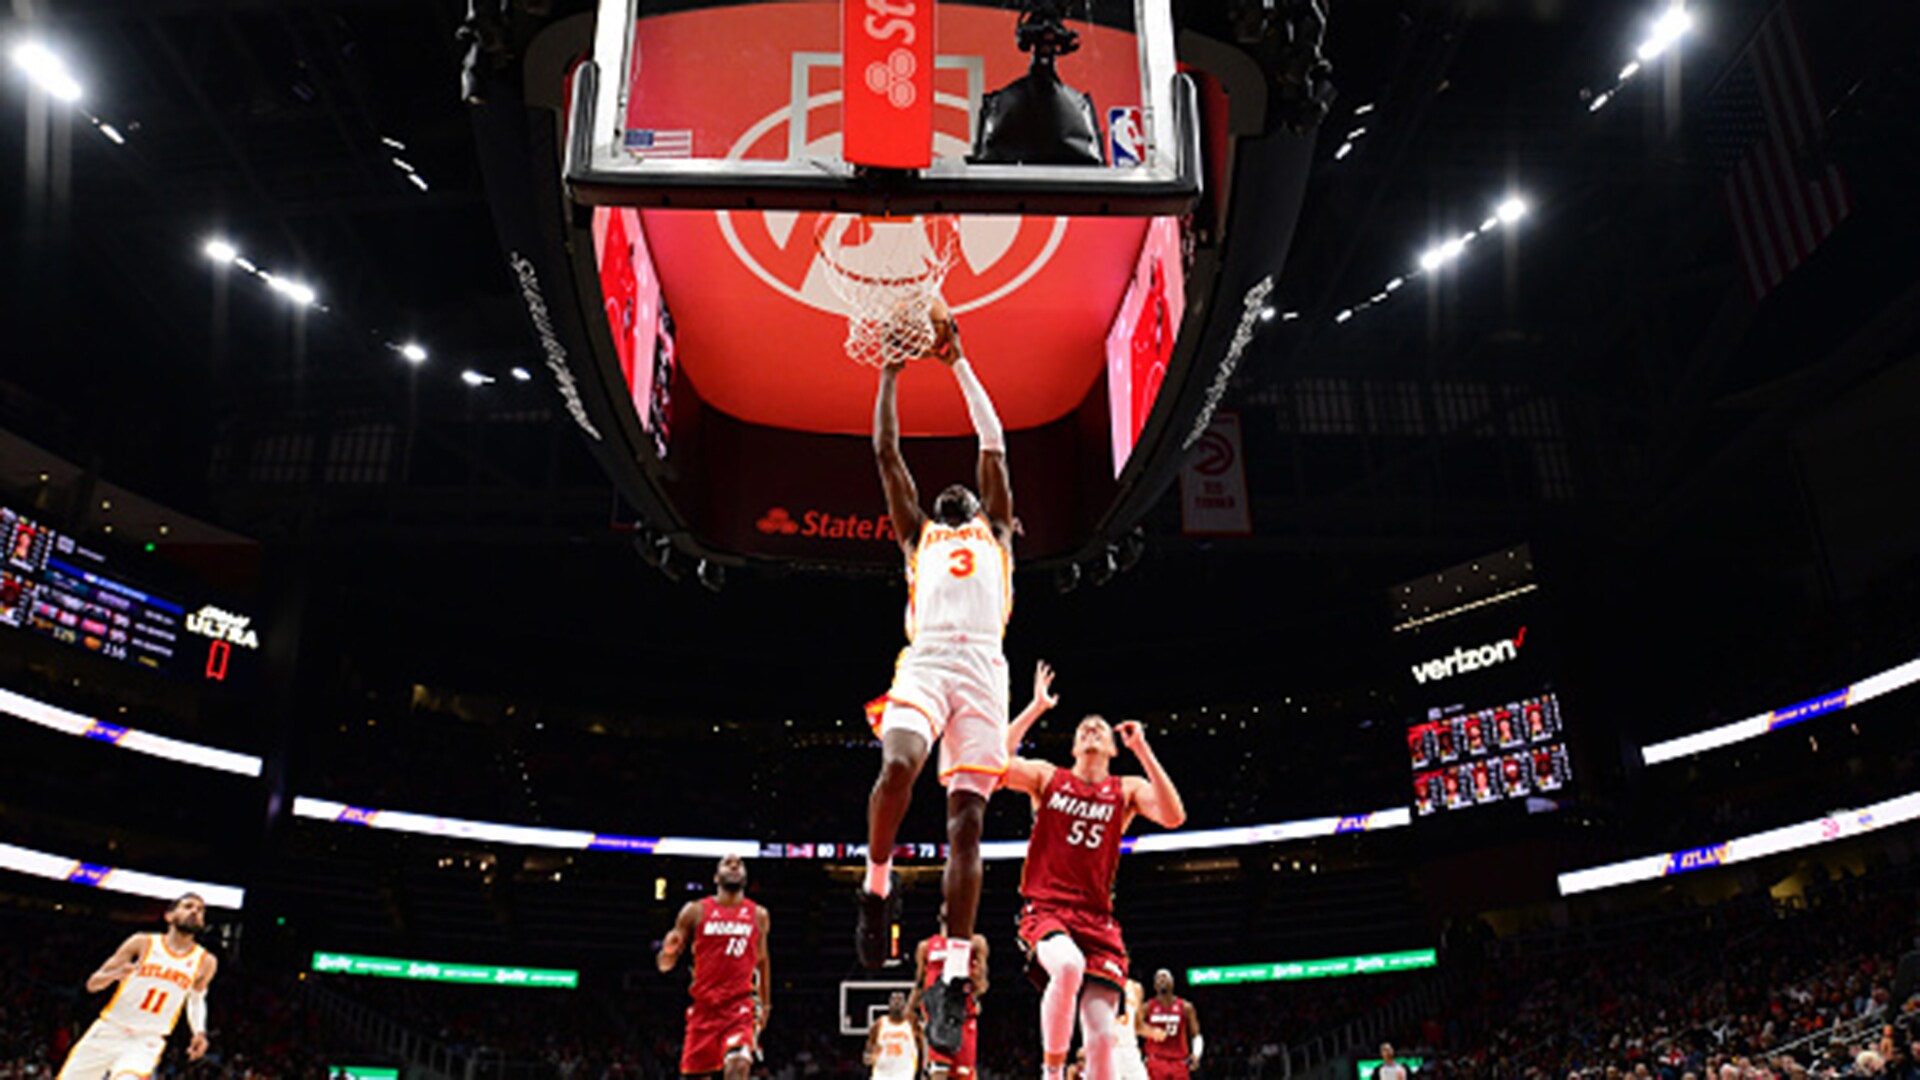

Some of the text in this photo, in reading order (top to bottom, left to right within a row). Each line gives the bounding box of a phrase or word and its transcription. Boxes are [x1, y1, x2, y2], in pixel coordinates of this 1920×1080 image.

[949, 548, 975, 578] 3
[185, 613, 259, 649] ULTRA
[1411, 638, 1518, 684] verizon
[1047, 791, 1115, 822] MIAMI
[1066, 820, 1105, 848] 55
[139, 987, 169, 1015] 11
